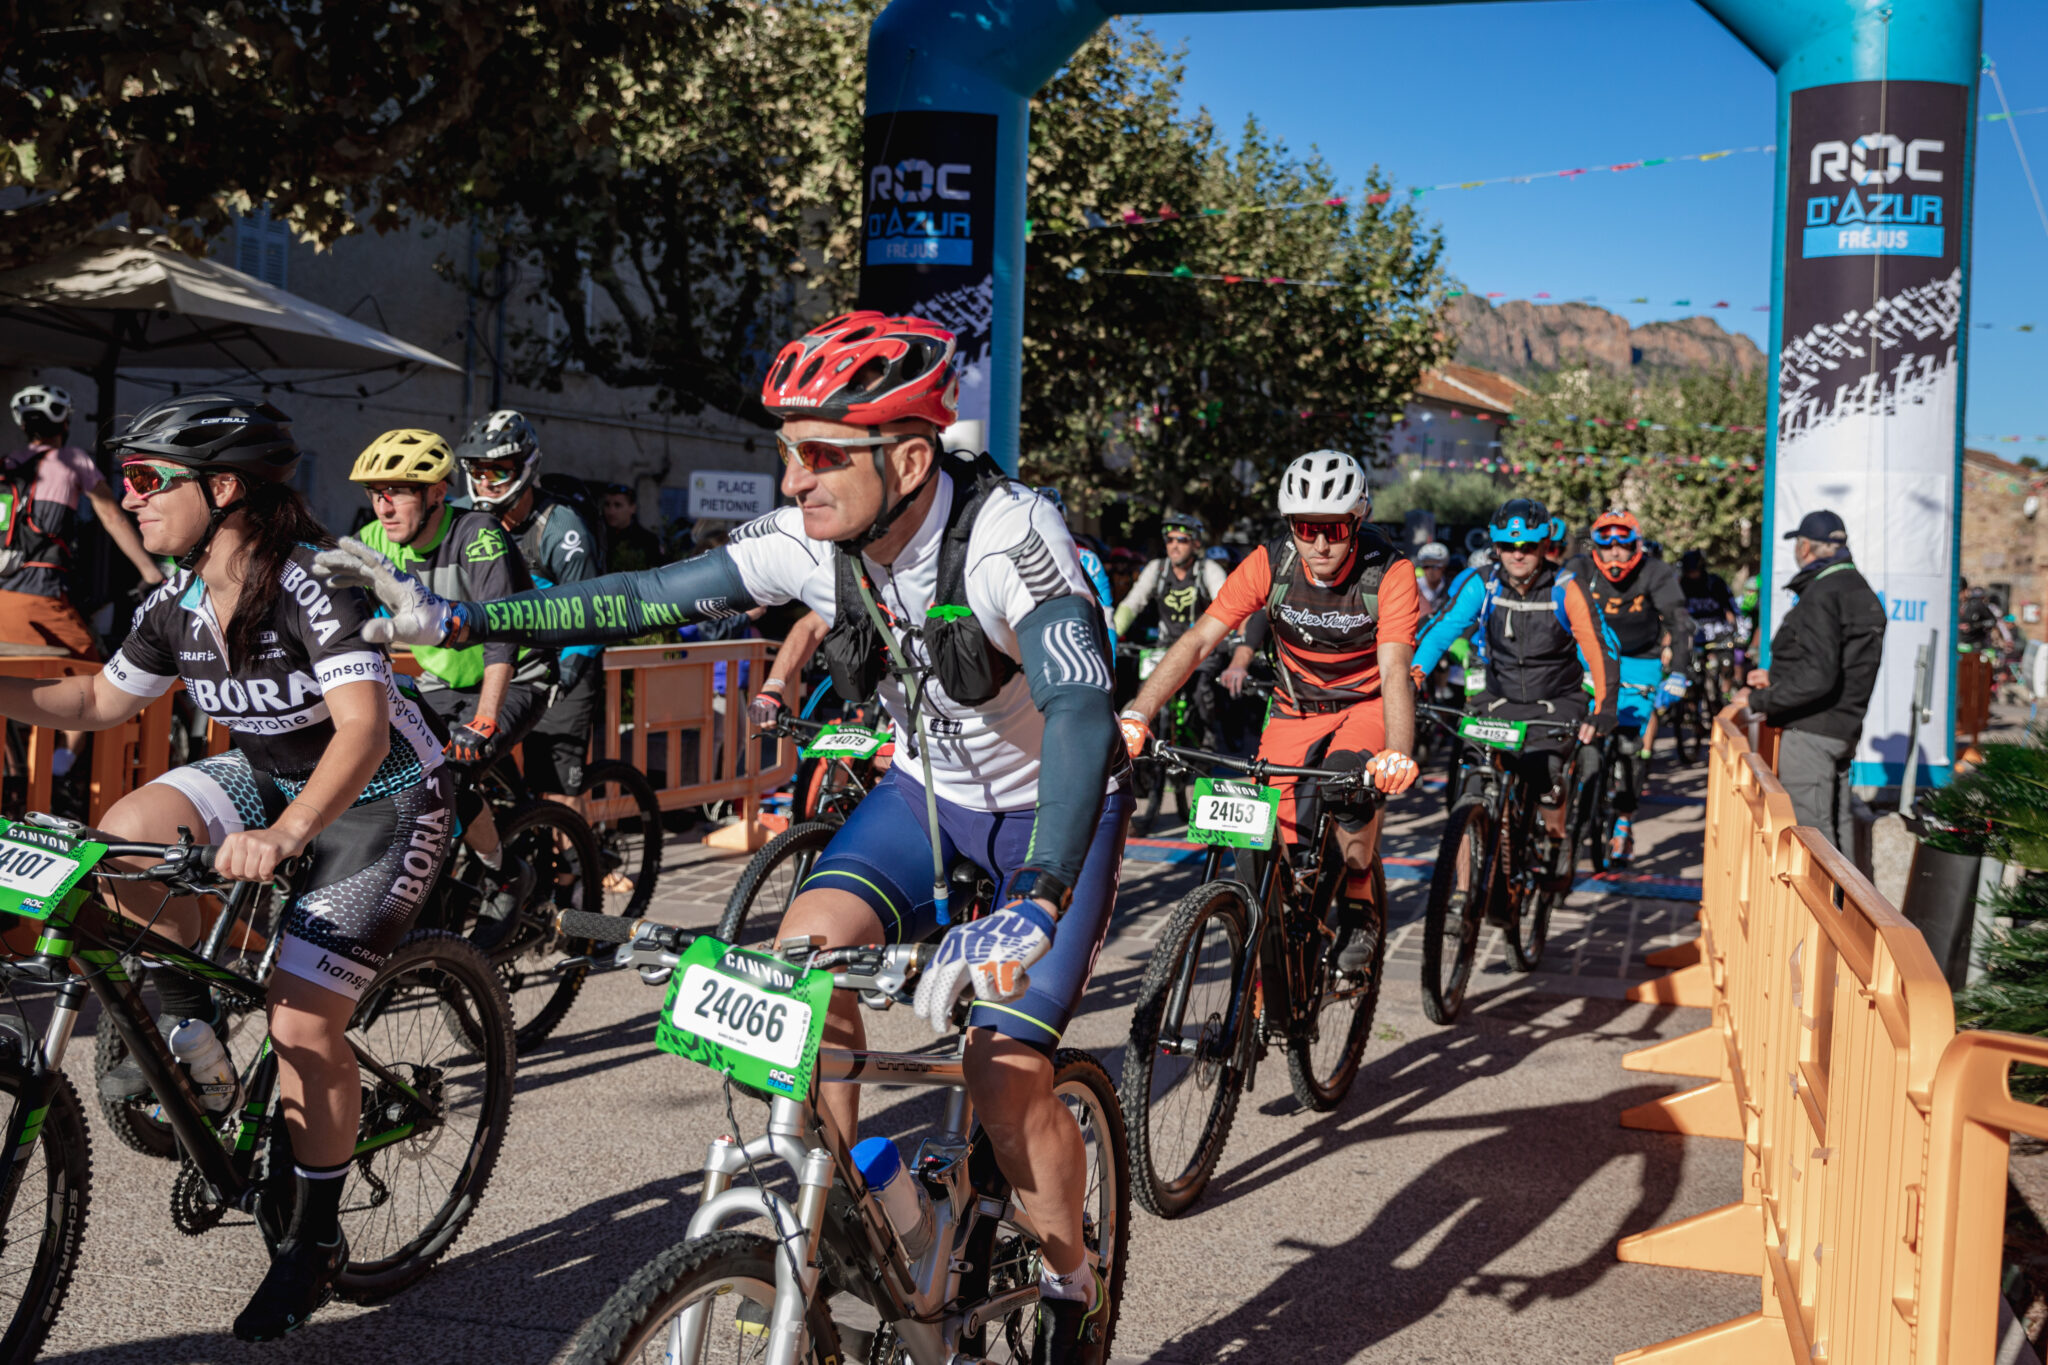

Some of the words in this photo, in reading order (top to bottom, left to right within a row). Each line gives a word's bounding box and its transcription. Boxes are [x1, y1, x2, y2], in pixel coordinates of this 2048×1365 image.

[1809, 132, 1945, 186] ROC
[869, 158, 972, 204] ROC
[868, 206, 972, 238] D'AZUR
[1806, 187, 1944, 227] D'AZUR
[886, 240, 939, 259] FRÉJUS
[1838, 226, 1908, 250] FRÉJUS
[779, 395, 818, 407] catlike
[717, 480, 757, 495] PLACE
[700, 498, 760, 514] PIETONNE
[283, 566, 342, 646] BORA
[489, 596, 586, 638] BRUYÈRES
[595, 595, 627, 629] DES
[1300, 609, 1322, 626] Lee
[1321, 611, 1372, 634] Designs
[194, 670, 323, 714] BORA
[825, 735, 867, 747] 24079
[1213, 784, 1258, 797] CANYON
[1209, 800, 1256, 824] 24153
[9, 828, 70, 852] CANYON
[390, 808, 446, 903] BORA
[0, 843, 57, 880] 4107
[351, 946, 386, 967] CRAFT
[724, 952, 795, 989] CANYON
[694, 978, 788, 1043] 24066
[42, 1188, 79, 1323] SCHWALBE
